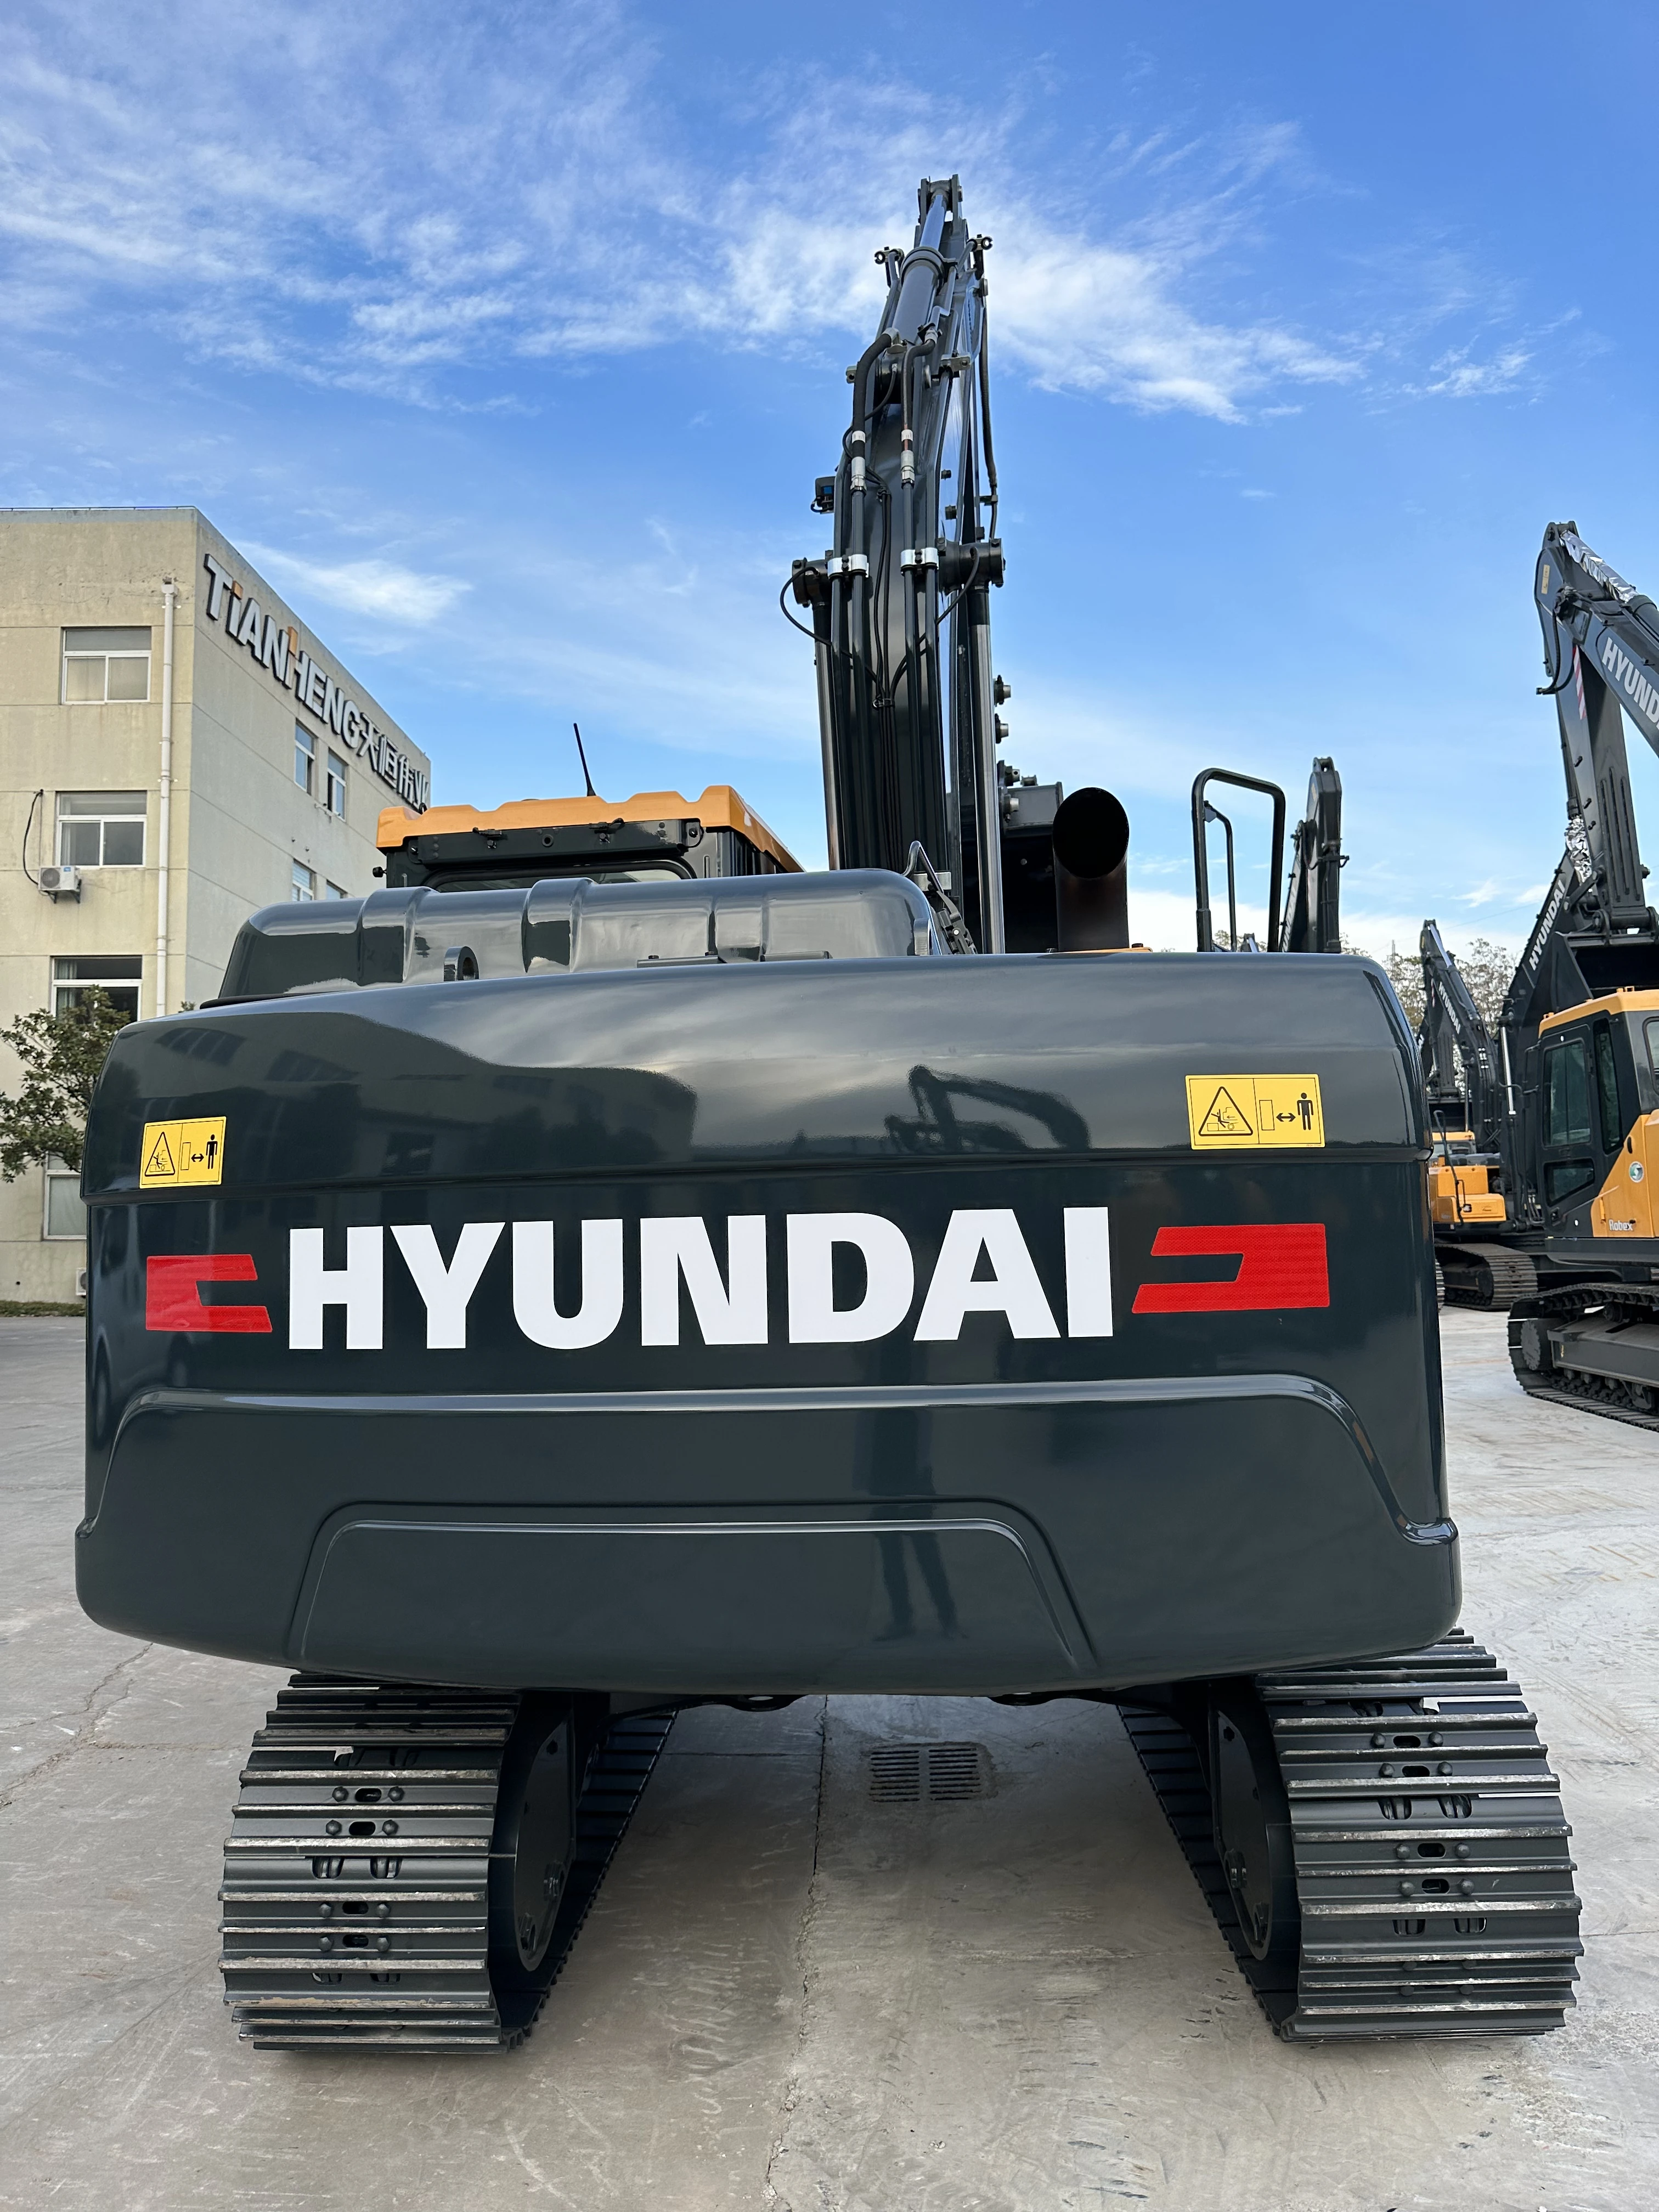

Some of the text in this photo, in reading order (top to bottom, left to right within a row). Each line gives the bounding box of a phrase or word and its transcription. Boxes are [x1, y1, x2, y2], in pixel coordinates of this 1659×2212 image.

[1601, 636, 1659, 730] HYUND
[1529, 879, 1565, 970] HYUNDAI
[1438, 981, 1461, 1034] HYUNDAI
[1609, 1219, 1633, 1231] Robex
[289, 1206, 1114, 1350] HYUNDAI
